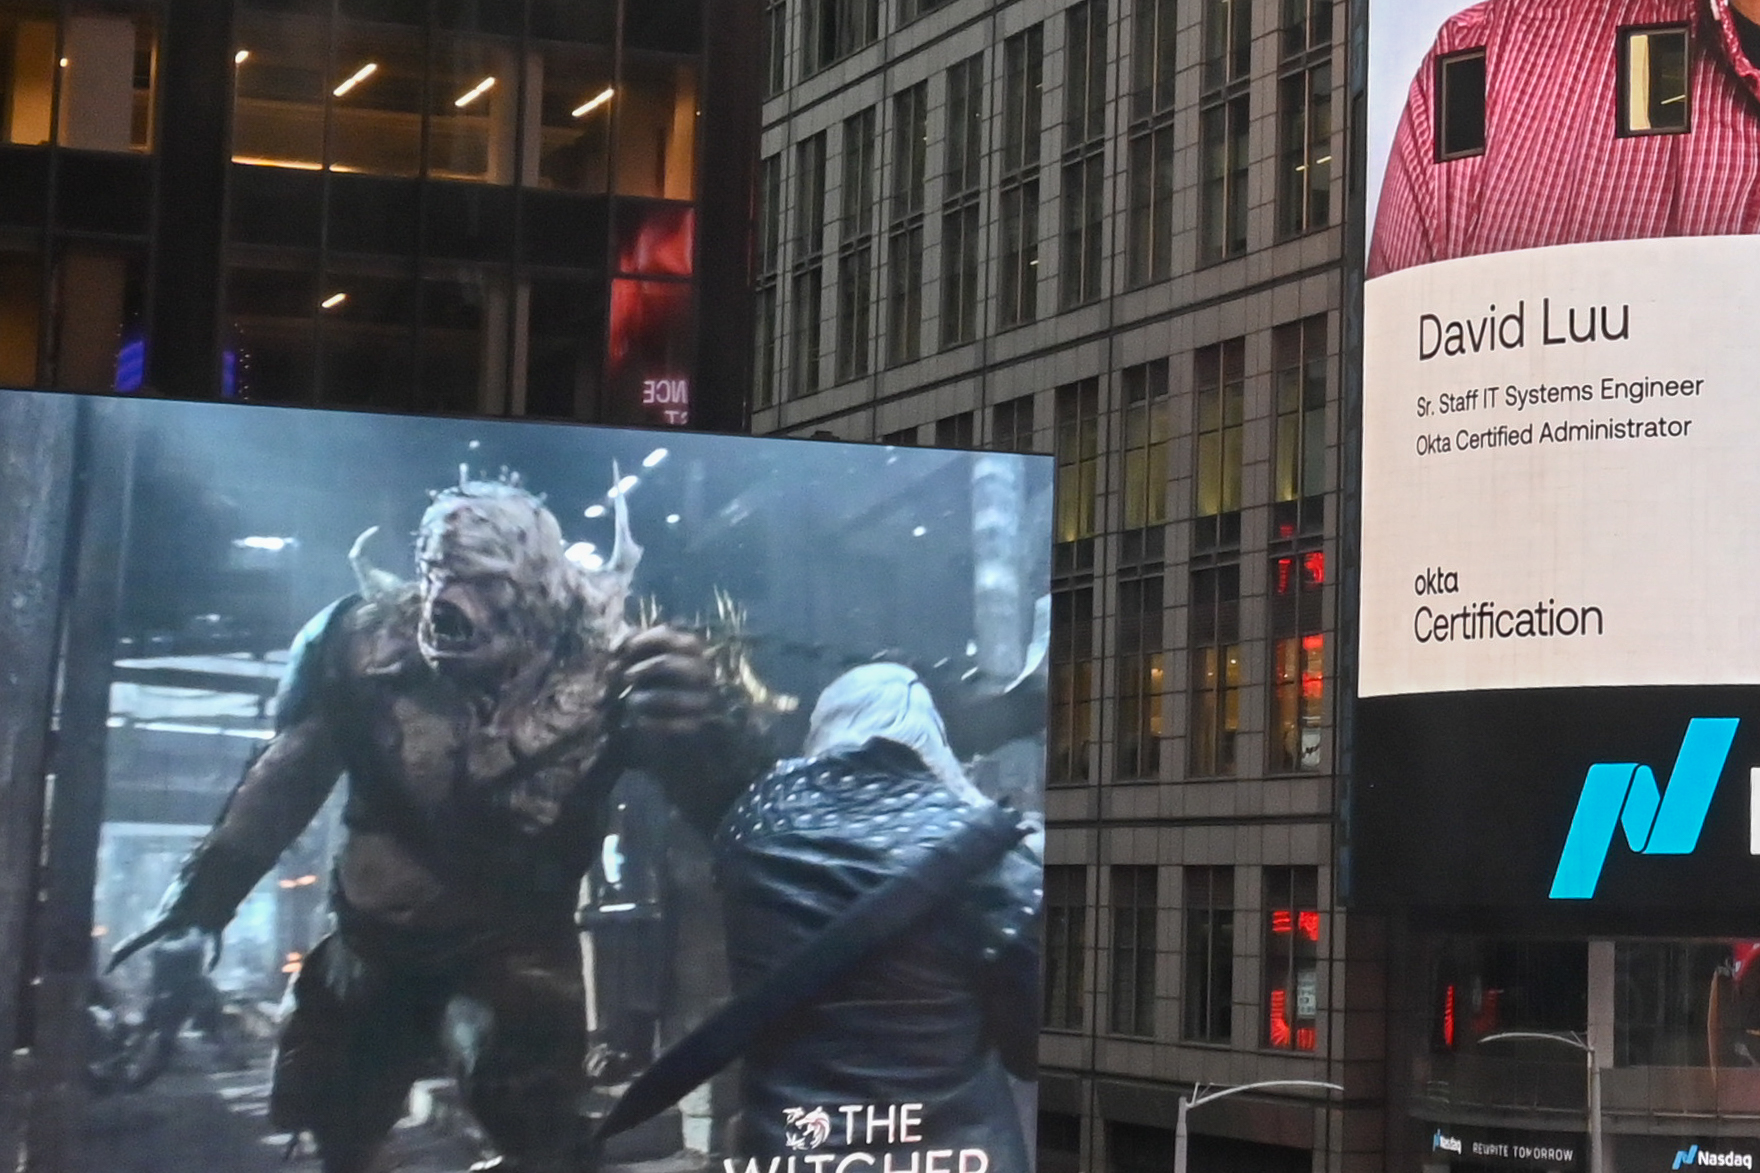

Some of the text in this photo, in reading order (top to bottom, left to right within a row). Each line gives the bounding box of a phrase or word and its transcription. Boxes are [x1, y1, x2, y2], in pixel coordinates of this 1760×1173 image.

[1419, 297, 1629, 361] David Luu
[1416, 377, 1704, 417] Sr. Staff IT Systems Engineer
[1416, 417, 1692, 456] Okta Certified Administrator
[1414, 566, 1459, 596] okta
[1414, 598, 1603, 643] Certification
[838, 1103, 923, 1145] THE
[1473, 1142, 1573, 1161] REWRITE TOMORROW
[1697, 1150, 1752, 1170] Nasdaq
